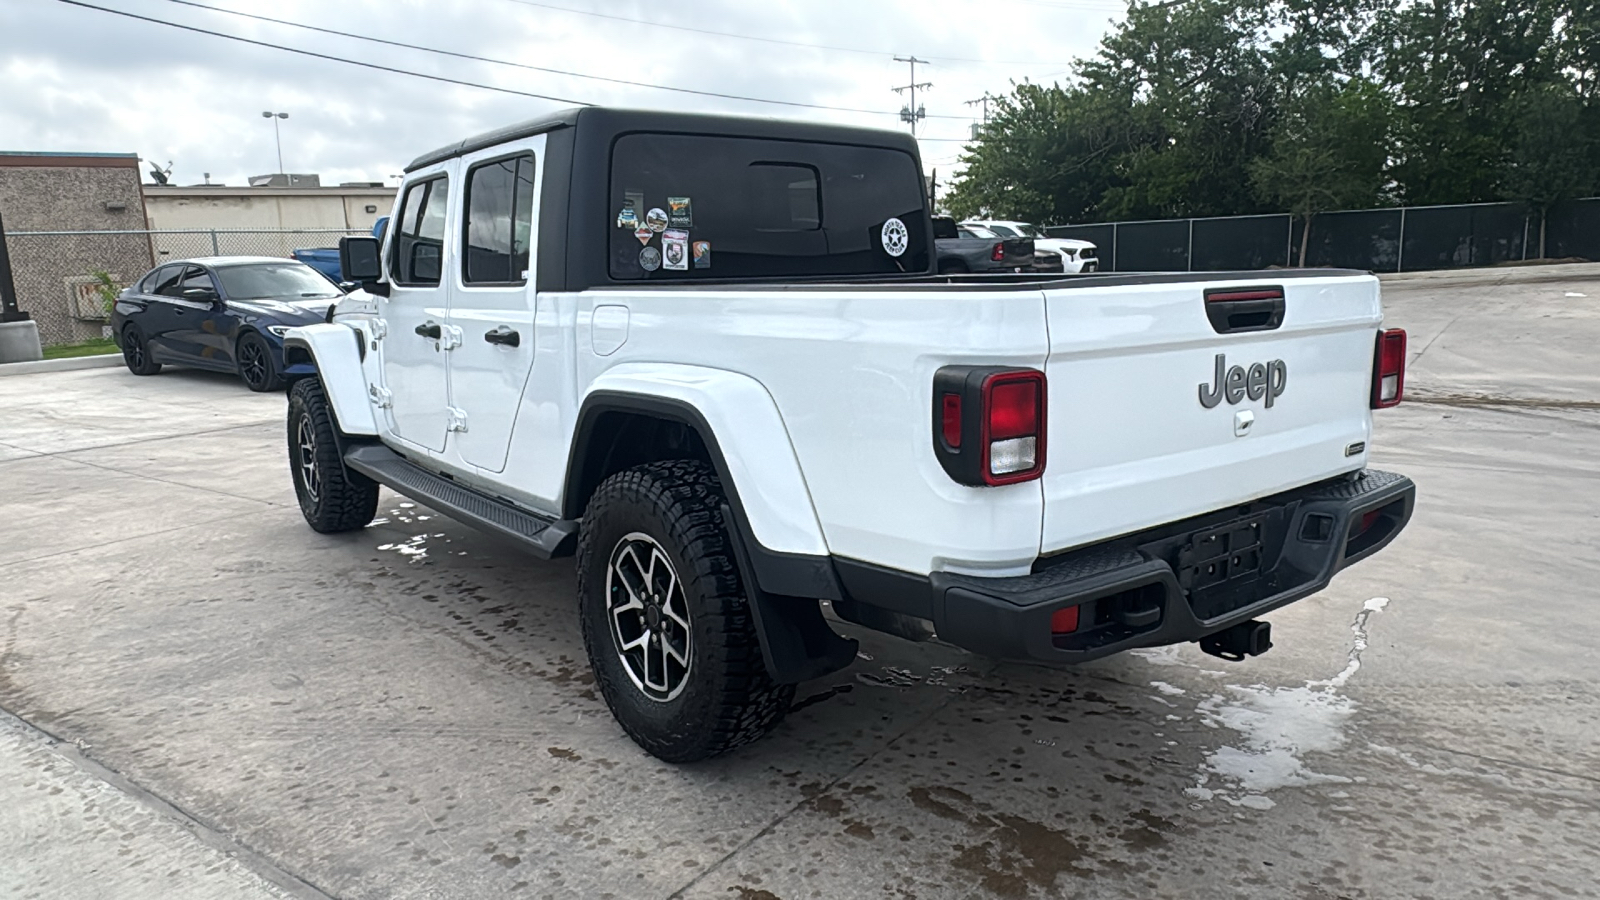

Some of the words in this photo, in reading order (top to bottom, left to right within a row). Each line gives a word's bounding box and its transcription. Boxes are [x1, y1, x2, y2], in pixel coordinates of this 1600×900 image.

[884, 221, 894, 236] NORTH
[895, 221, 906, 237] TEXAS
[885, 243, 894, 253] JEEP
[895, 243, 905, 253] CLUB
[1198, 353, 1287, 409] Jeep
